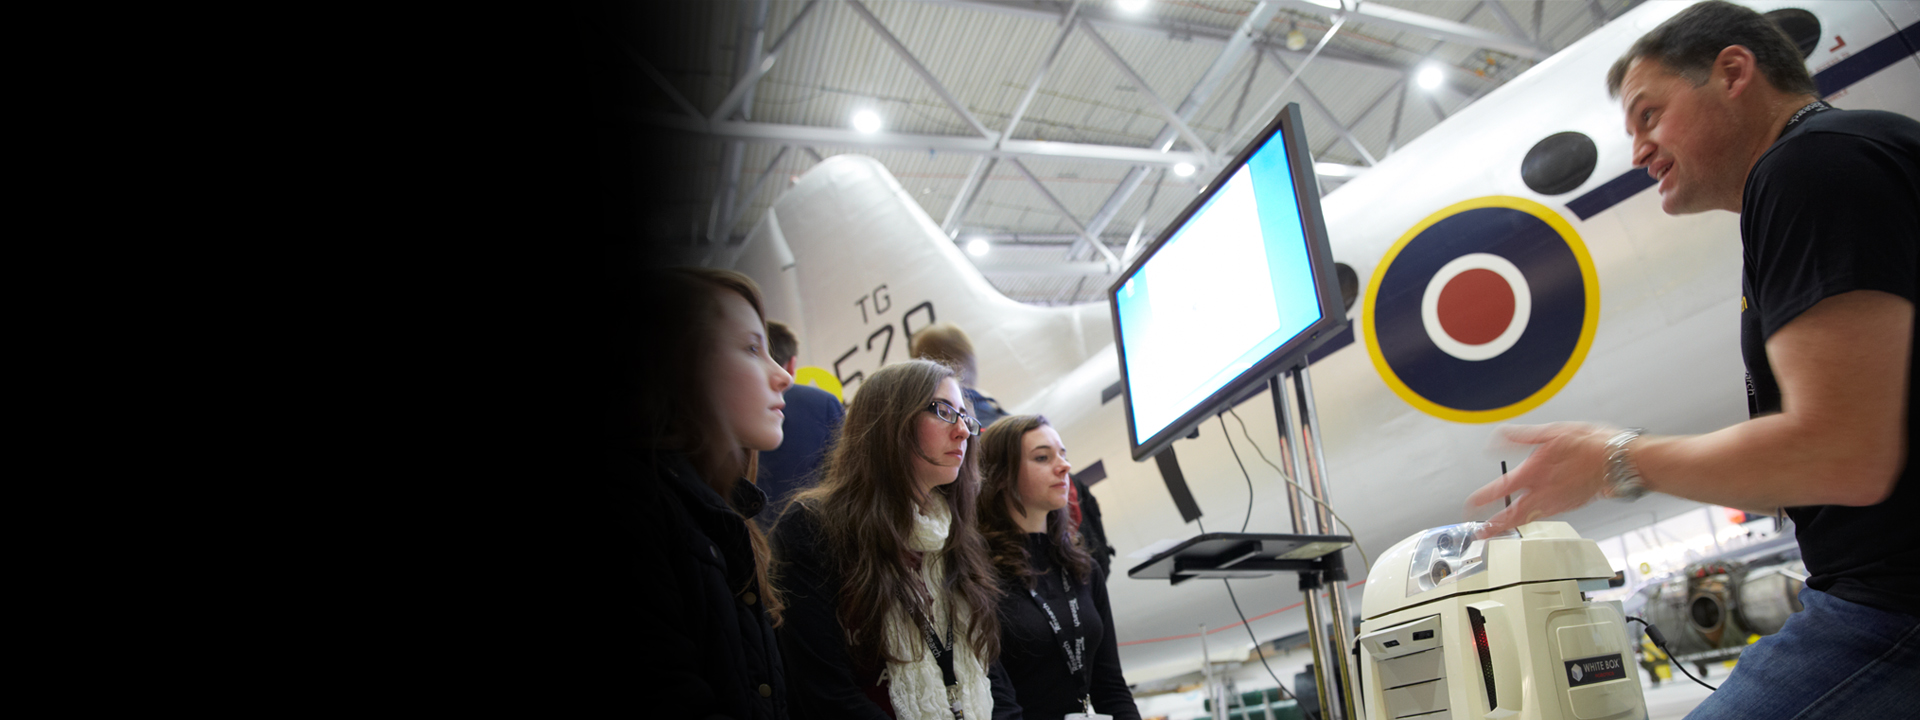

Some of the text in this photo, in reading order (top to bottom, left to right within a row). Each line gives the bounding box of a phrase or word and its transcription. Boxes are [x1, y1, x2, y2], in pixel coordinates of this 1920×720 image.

[854, 283, 891, 324] TG
[1583, 659, 1620, 673] WHITE BOX
